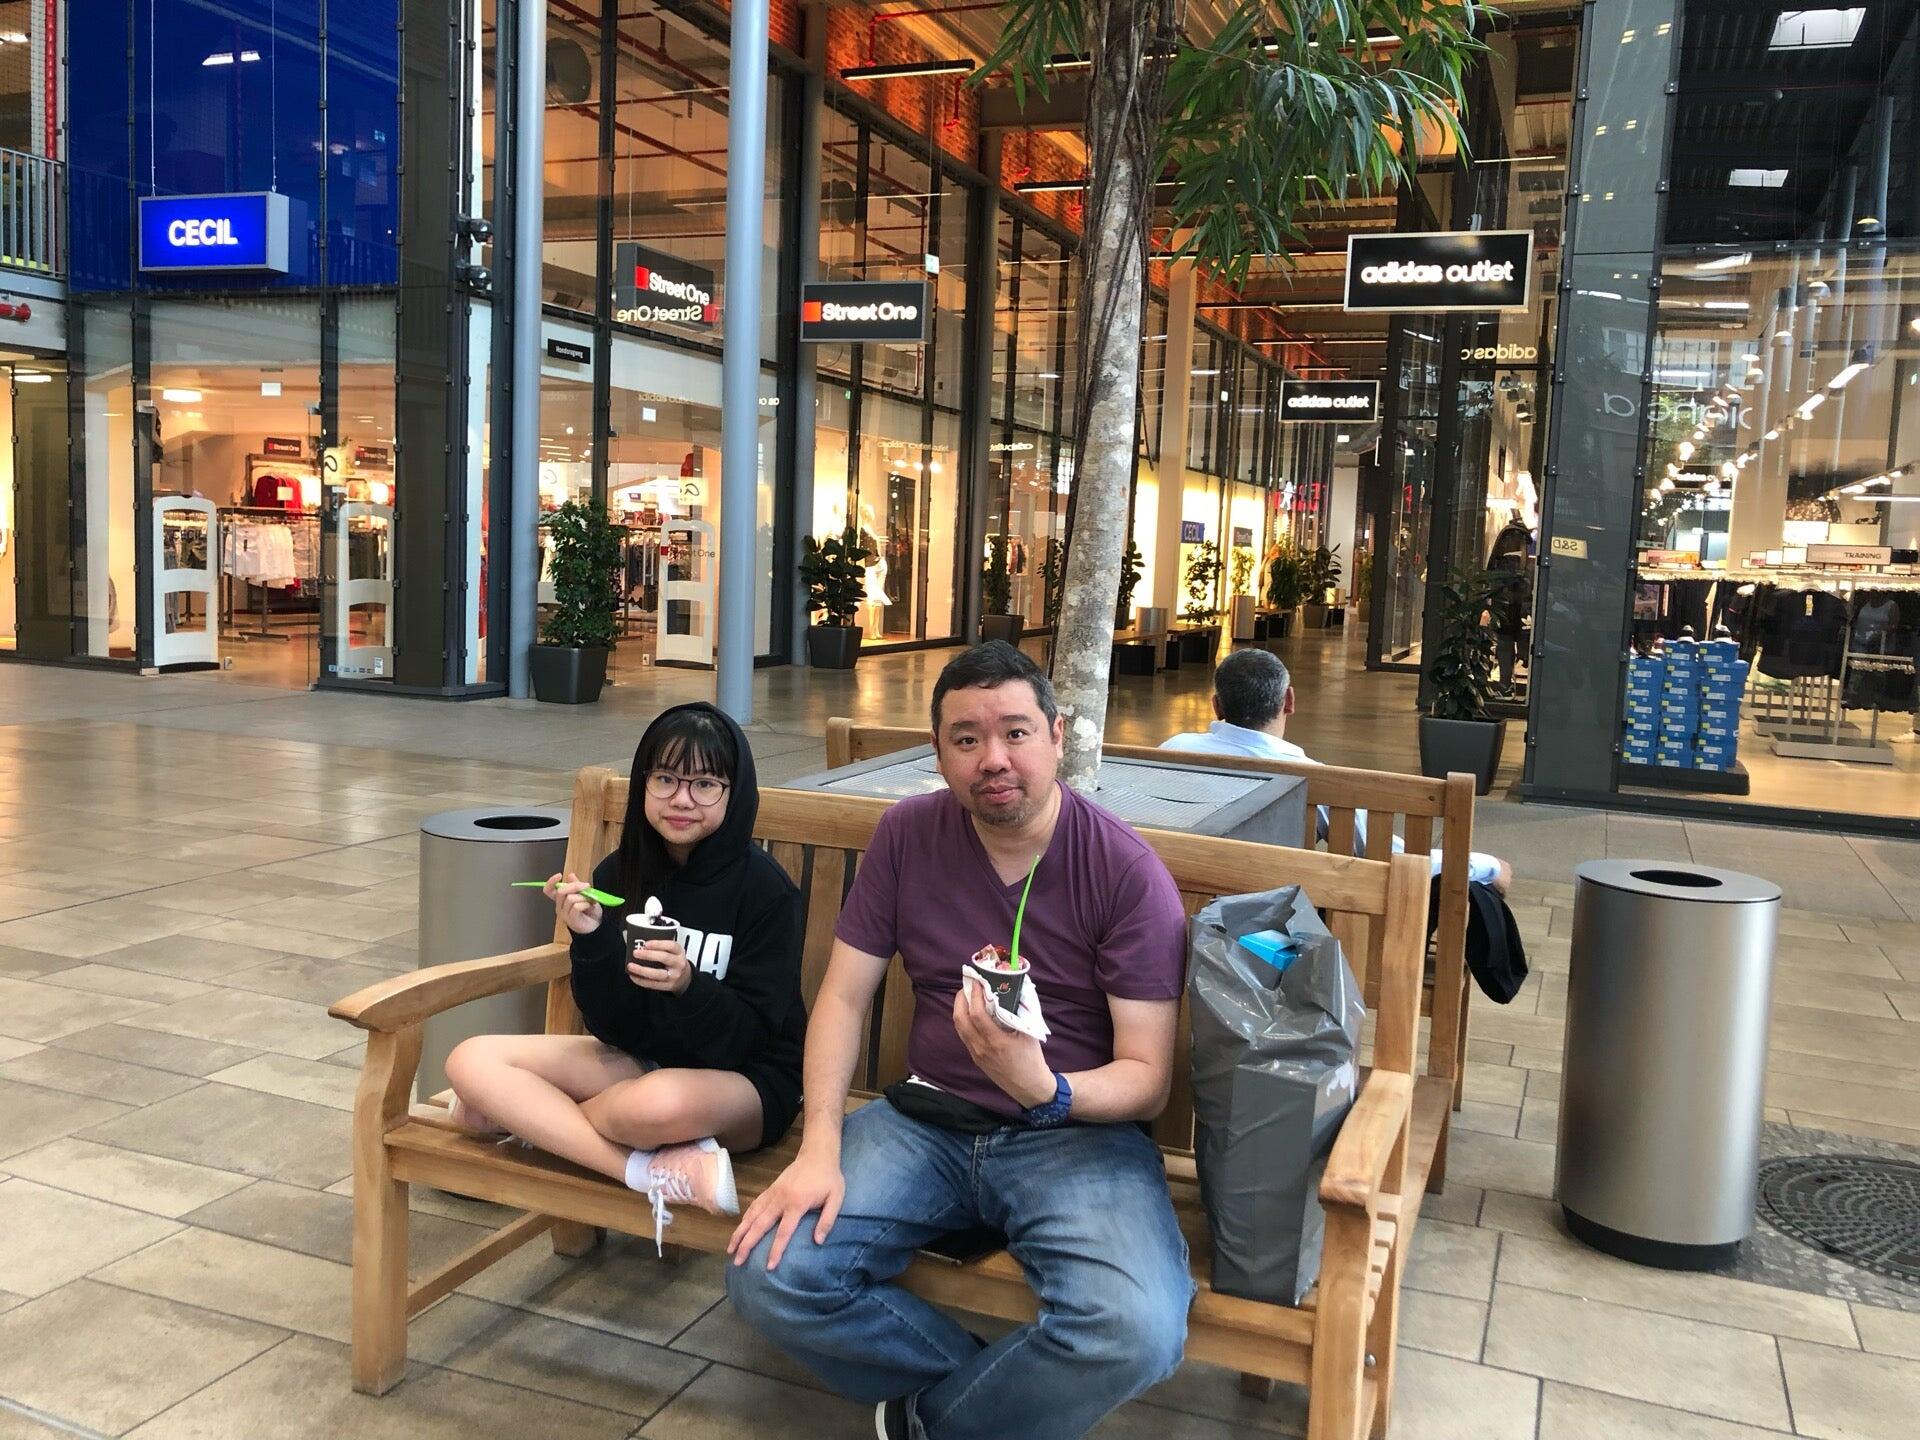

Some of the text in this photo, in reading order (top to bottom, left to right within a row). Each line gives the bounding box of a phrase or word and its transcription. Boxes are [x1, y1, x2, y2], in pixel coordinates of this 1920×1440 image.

[168, 218, 239, 246] CECIL
[1361, 260, 1514, 284] adidas outlet
[649, 271, 710, 306] Street One
[822, 302, 918, 321] Street One
[1287, 395, 1370, 408] adidas outlet
